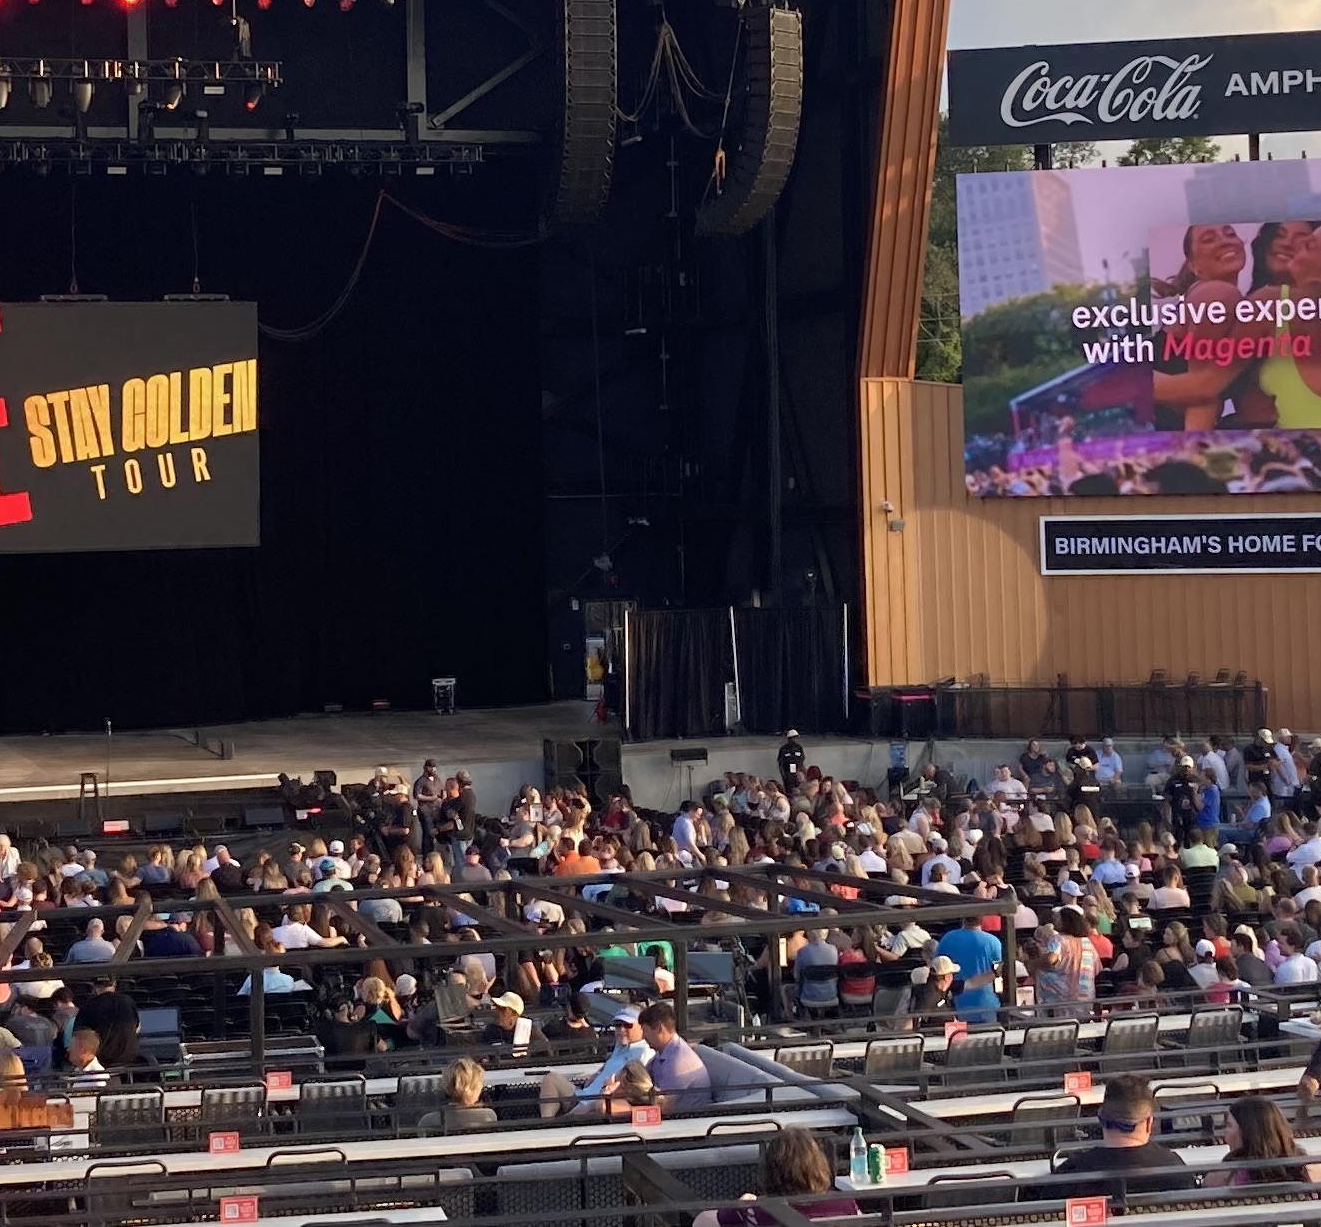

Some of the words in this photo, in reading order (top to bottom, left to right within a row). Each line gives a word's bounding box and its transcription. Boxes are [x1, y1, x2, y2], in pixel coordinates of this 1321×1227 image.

[1000, 53, 1214, 127] Coca-Cola
[1072, 296, 1226, 329] exclusive
[1083, 332, 1154, 364] with
[1163, 330, 1312, 367] Magenta
[24, 383, 115, 468] STAY
[122, 358, 257, 453] GOLDEN
[90, 447, 211, 500] TOUR
[1055, 534, 1222, 555] BIRMINGHAM'S
[1228, 534, 1296, 554] HOME
